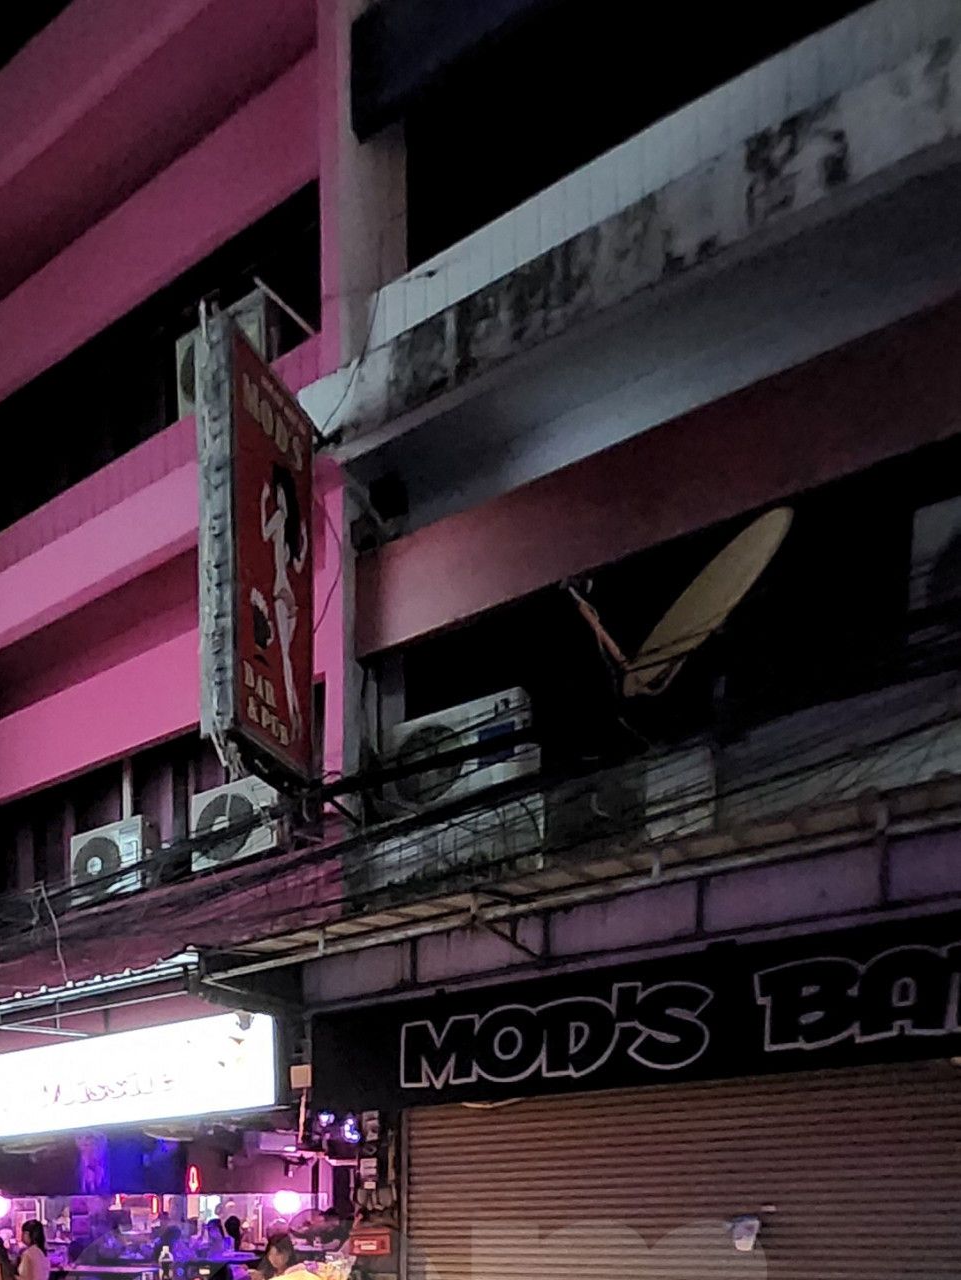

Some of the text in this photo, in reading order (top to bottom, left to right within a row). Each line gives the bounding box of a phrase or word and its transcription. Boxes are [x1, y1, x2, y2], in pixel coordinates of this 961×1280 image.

[242, 660, 278, 708] BAR
[400, 943, 961, 1089] MOD'S BA
